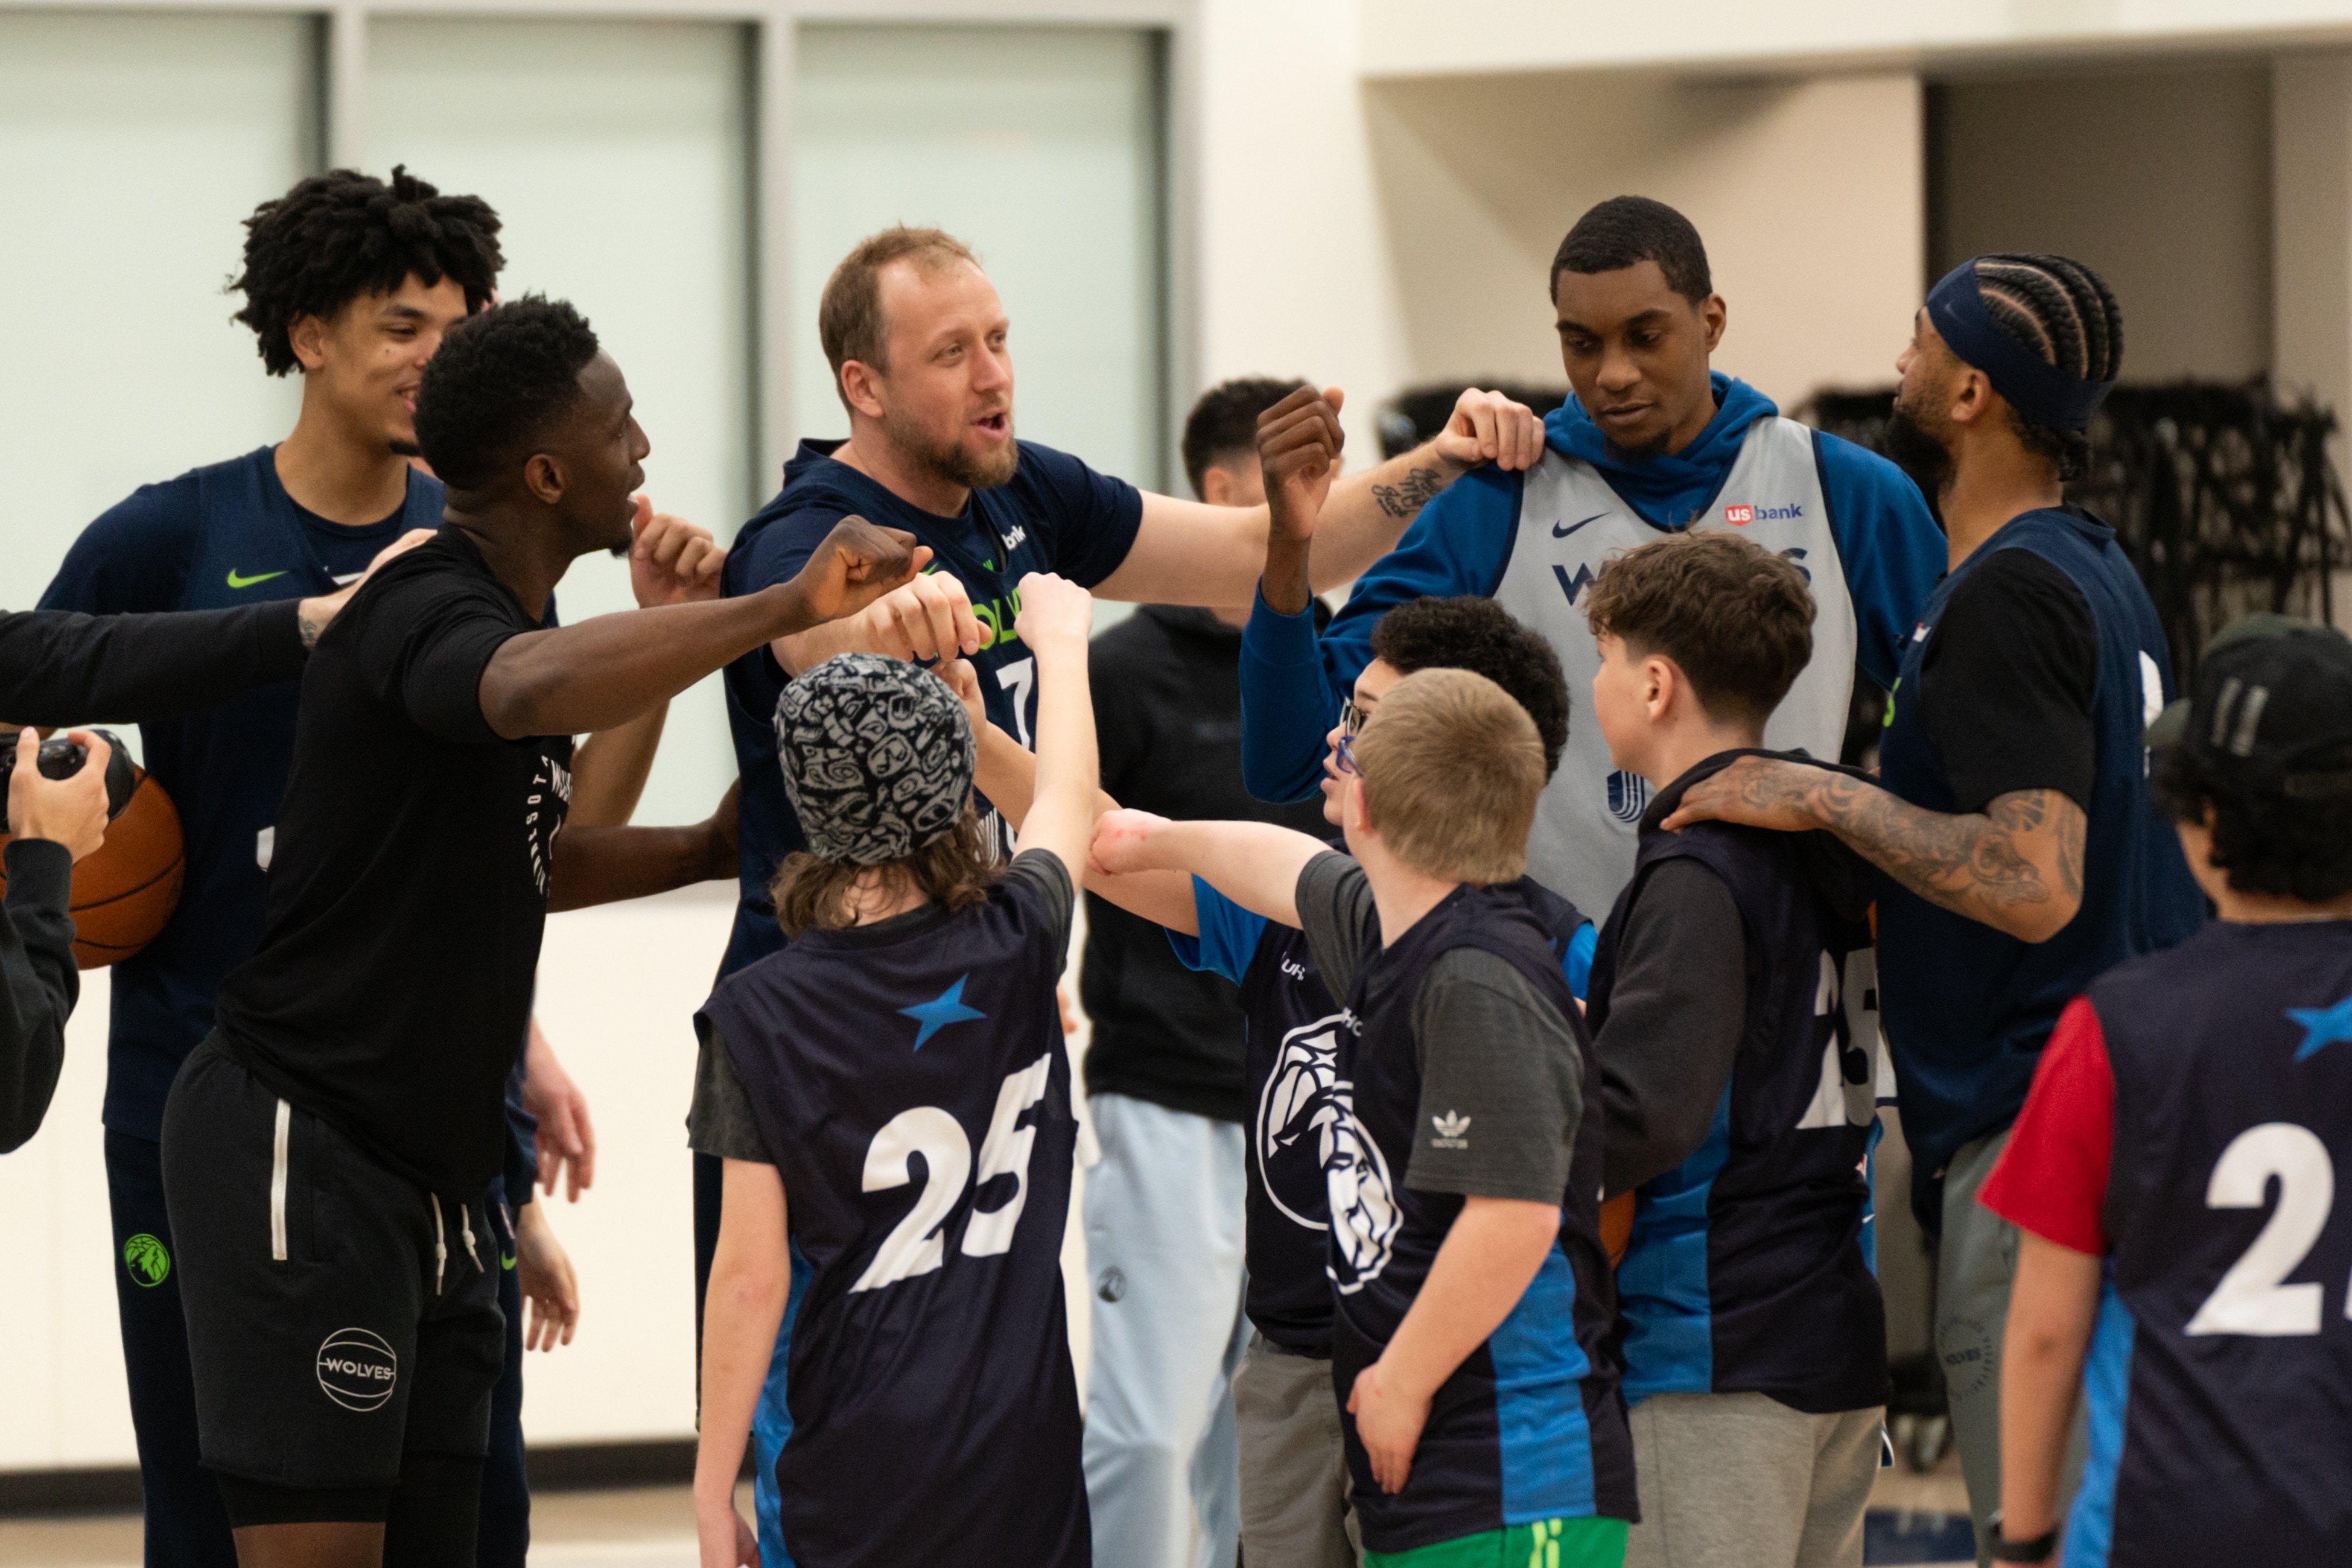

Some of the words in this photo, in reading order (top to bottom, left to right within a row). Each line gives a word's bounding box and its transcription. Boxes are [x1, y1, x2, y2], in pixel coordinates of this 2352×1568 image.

[1002, 525, 1026, 550] bnk
[1727, 509, 1751, 521] us
[1754, 503, 1802, 520] bank
[996, 656, 1033, 751] 7
[848, 1052, 1052, 1295] 25
[2182, 1122, 2352, 1336] 2
[326, 1357, 392, 1380] WOLVES
